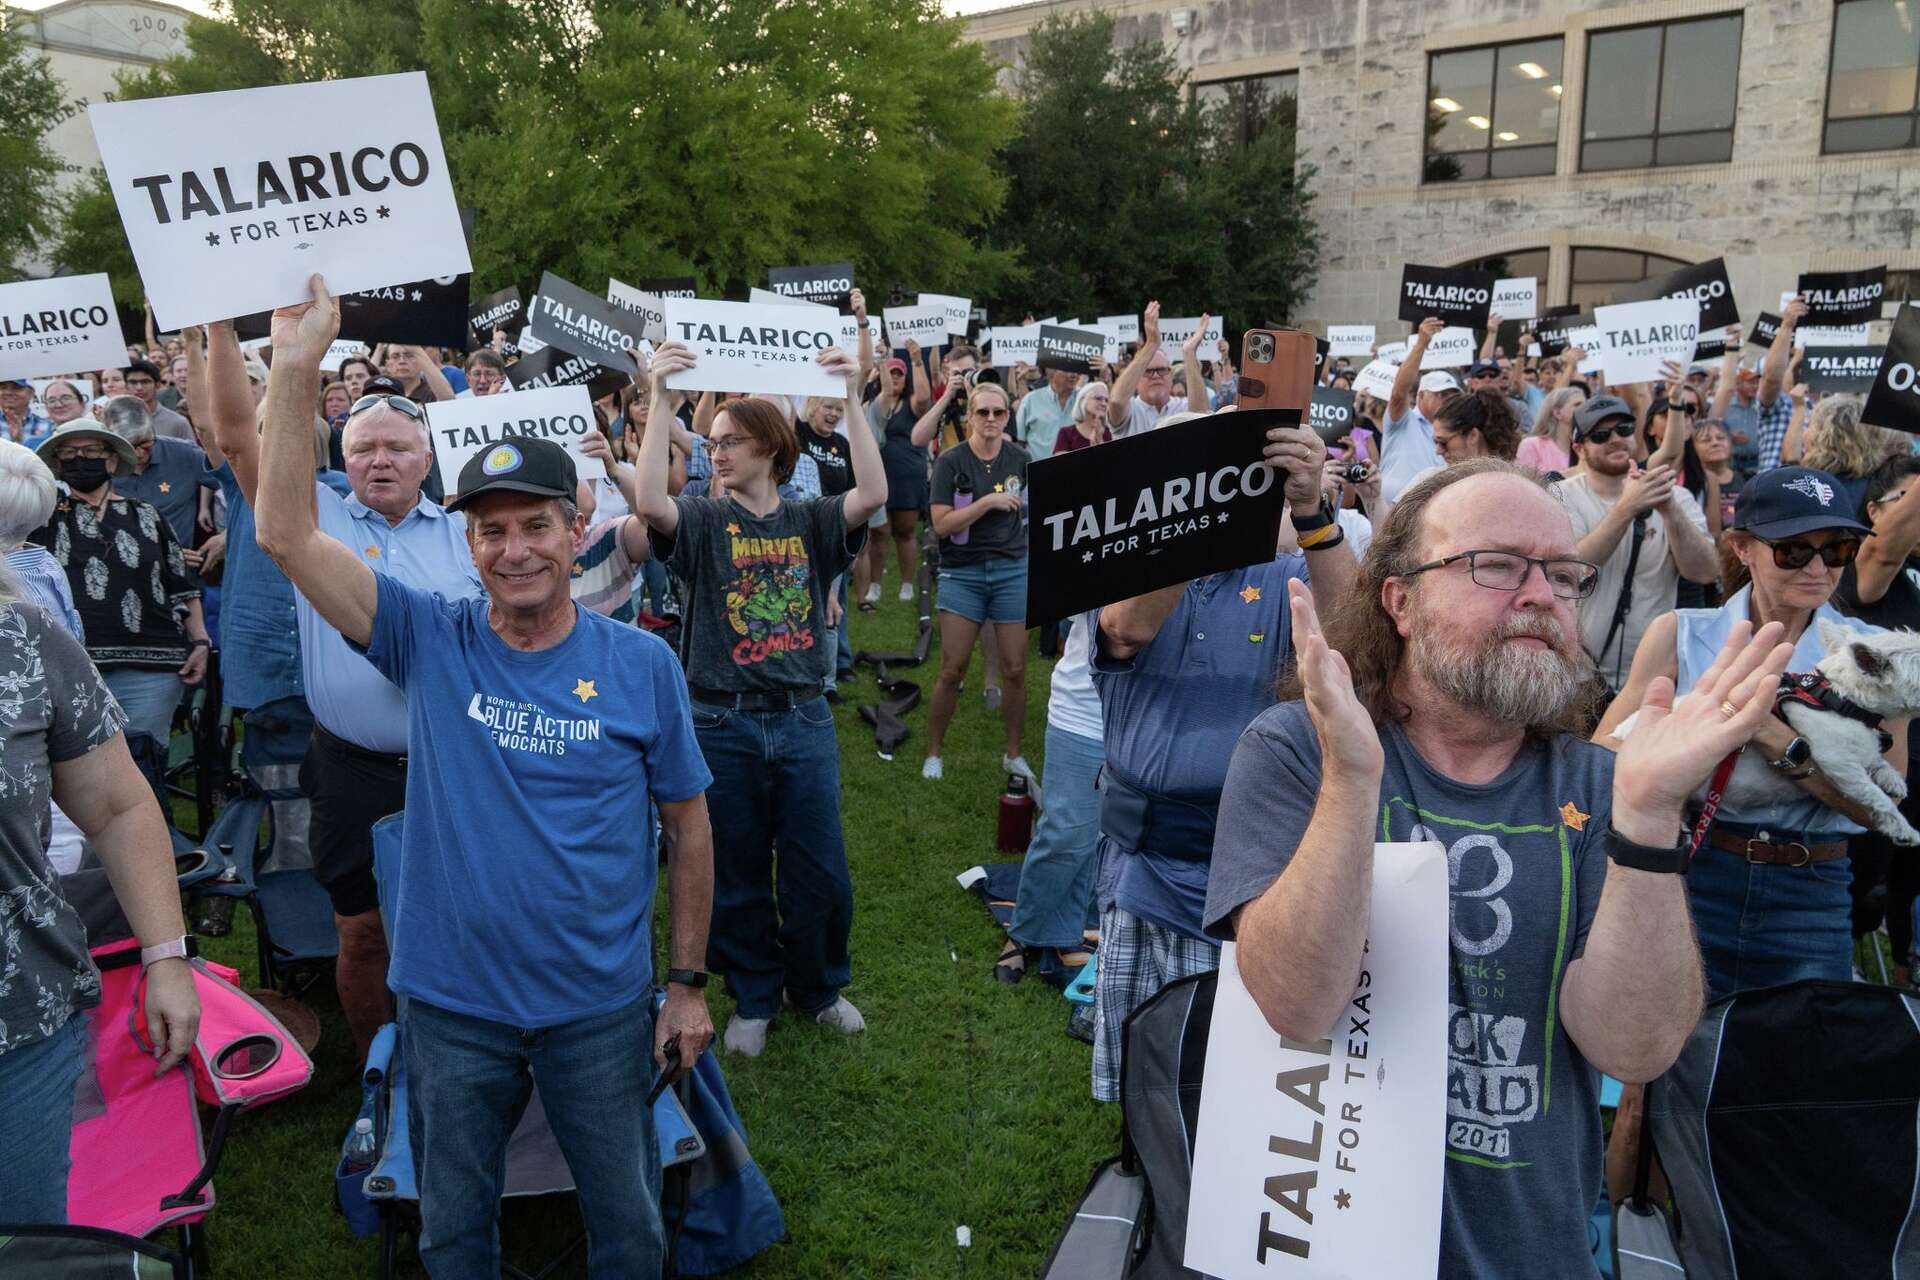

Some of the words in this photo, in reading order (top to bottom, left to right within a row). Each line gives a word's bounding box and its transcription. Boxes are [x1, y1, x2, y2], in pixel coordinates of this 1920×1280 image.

[130, 16, 181, 40] 2005
[133, 142, 429, 224] TALARICO
[231, 221, 279, 244] FOR
[287, 207, 369, 238] TEXAS
[773, 279, 850, 295] TALARICO
[1405, 282, 1488, 304] TALARICO
[1497, 290, 1533, 301] ARICO
[1802, 282, 1882, 304] TALARICO
[472, 299, 520, 328] TALARICO
[1440, 302, 1464, 311] TEXAS
[543, 296, 633, 350] TALARICO
[677, 322, 834, 350] TALARICO
[889, 317, 944, 331] TALARICO
[1605, 324, 1696, 348] TALARICO
[8, 340, 33, 350] FOR
[37, 335, 78, 347] TEXAS
[562, 325, 579, 338] FOR
[581, 335, 609, 352] TEXAS
[996, 339, 1040, 348] TALARIC
[1042, 337, 1101, 355] TALARICO
[1433, 338, 1469, 349] ARICO
[719, 348, 746, 359] FOR
[752, 350, 797, 362] TEXAS
[442, 414, 588, 449] TALARICO
[1043, 461, 1275, 551] TALARICO
[1102, 535, 1138, 559] FOR
[1148, 515, 1210, 544] TEXAS
[731, 536, 810, 568] MARVEL
[732, 628, 815, 665] COMICS
[487, 695, 515, 708] NORTH
[485, 705, 529, 734] BLUE
[533, 714, 600, 741] ACTION
[491, 730, 565, 756] EMOCRATS
[1344, 968, 1373, 1084] TEXAS
[1335, 1101, 1363, 1174] FOR
[1453, 1125, 1508, 1153] 2011
